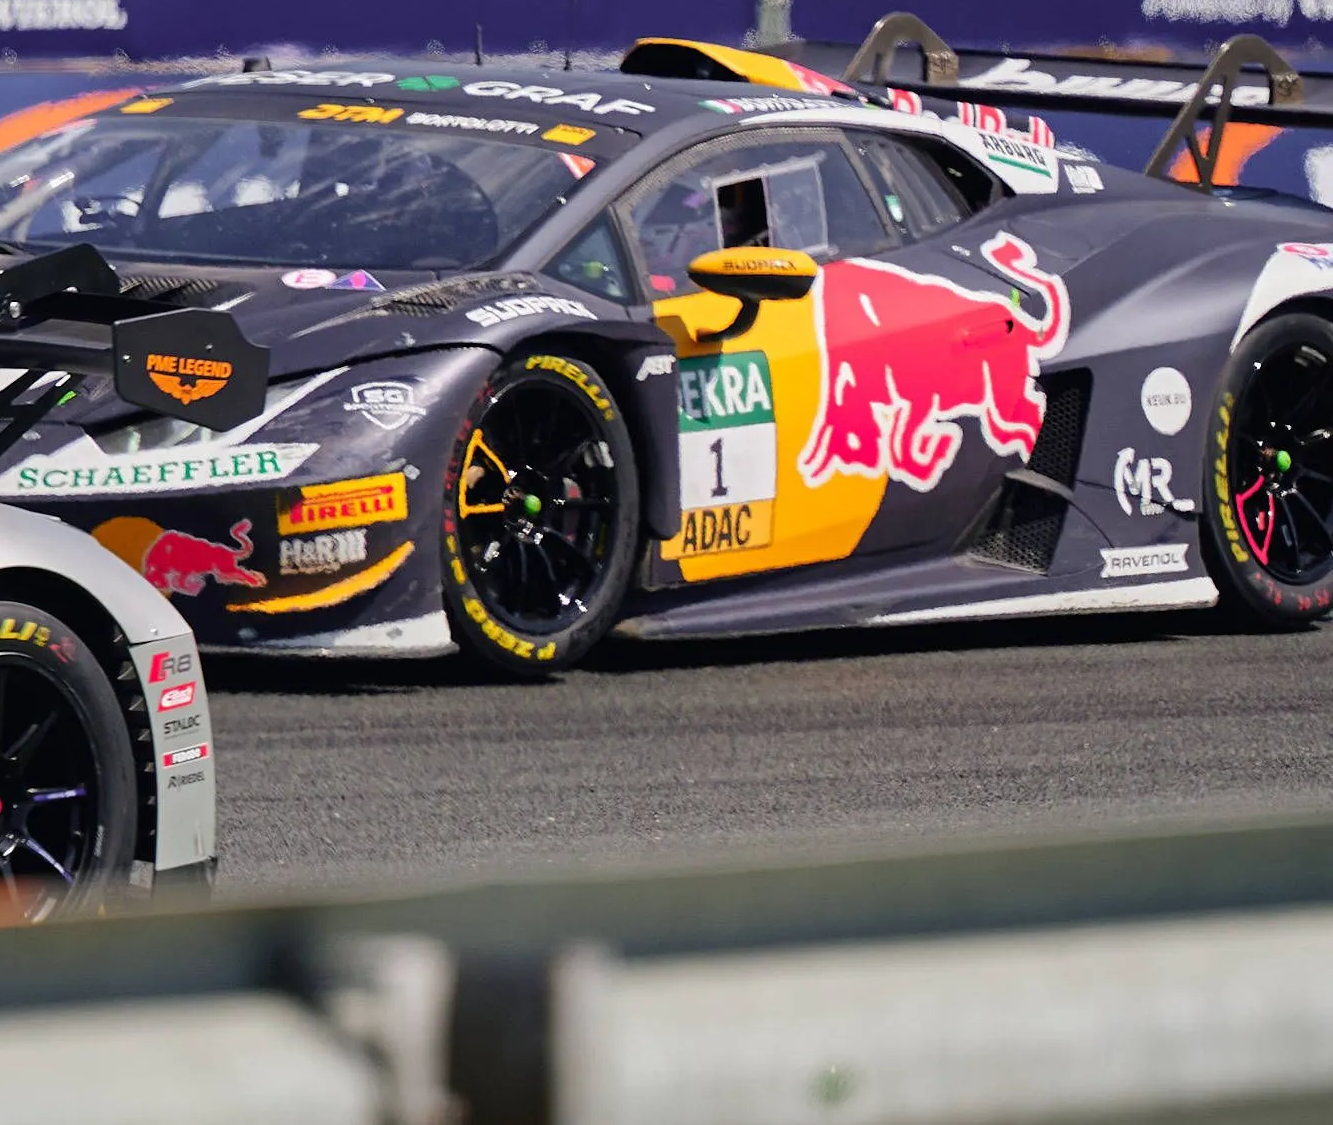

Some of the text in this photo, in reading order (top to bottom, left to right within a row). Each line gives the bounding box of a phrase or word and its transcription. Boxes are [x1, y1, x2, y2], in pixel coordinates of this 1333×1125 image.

[298, 104, 405, 125] DTM
[463, 80, 657, 116] GRAF
[146, 353, 233, 379] PME LEGEND
[524, 354, 616, 411] PIRELLI
[677, 362, 773, 421] EKRA
[17, 450, 282, 490] SCHAEFFLER
[709, 437, 729, 498] 1
[289, 489, 395, 524] PIRELLI
[683, 504, 752, 553] ADAC
[1111, 553, 1181, 569] RAVENOL
[154, 653, 193, 680] R8
